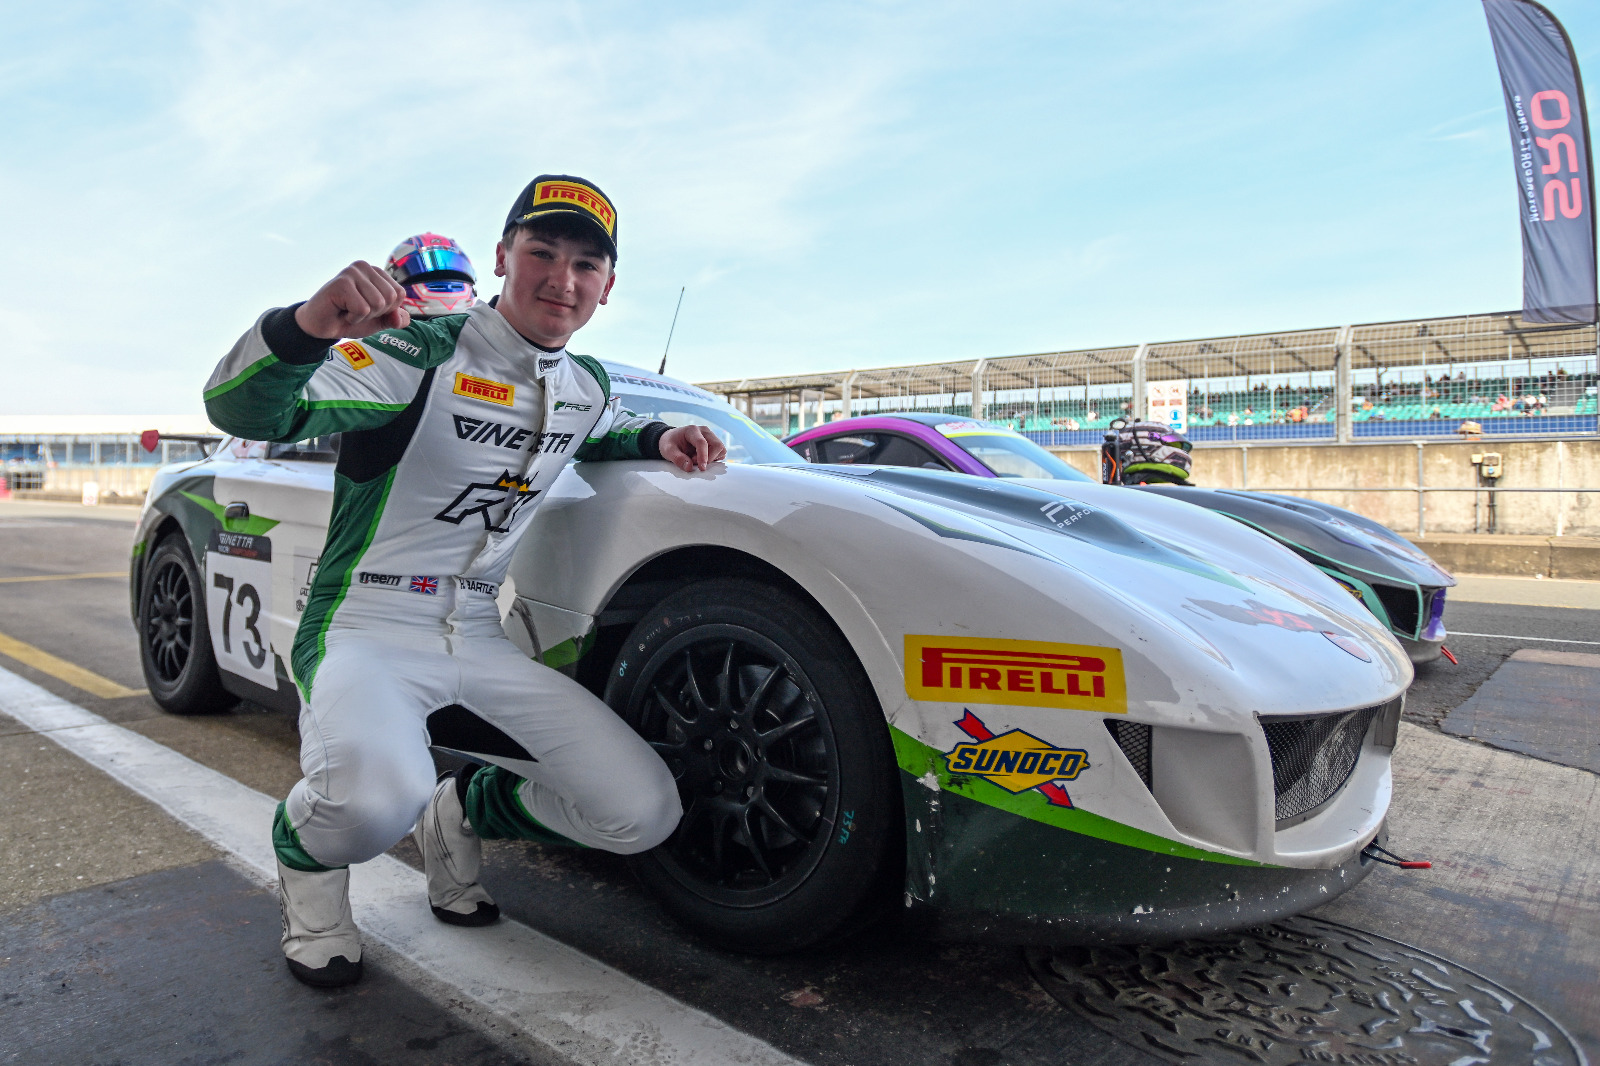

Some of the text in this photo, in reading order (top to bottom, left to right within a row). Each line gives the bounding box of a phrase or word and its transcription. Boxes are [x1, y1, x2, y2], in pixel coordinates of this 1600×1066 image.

[540, 184, 612, 226] PIRELLI
[378, 333, 422, 357] freem
[460, 378, 509, 401] PIRELLI
[219, 533, 254, 549] GINETTA
[359, 571, 402, 586] freem
[213, 572, 267, 670] 73
[921, 646, 1106, 698] PIRELLI
[951, 747, 1084, 777] SUNOCO
